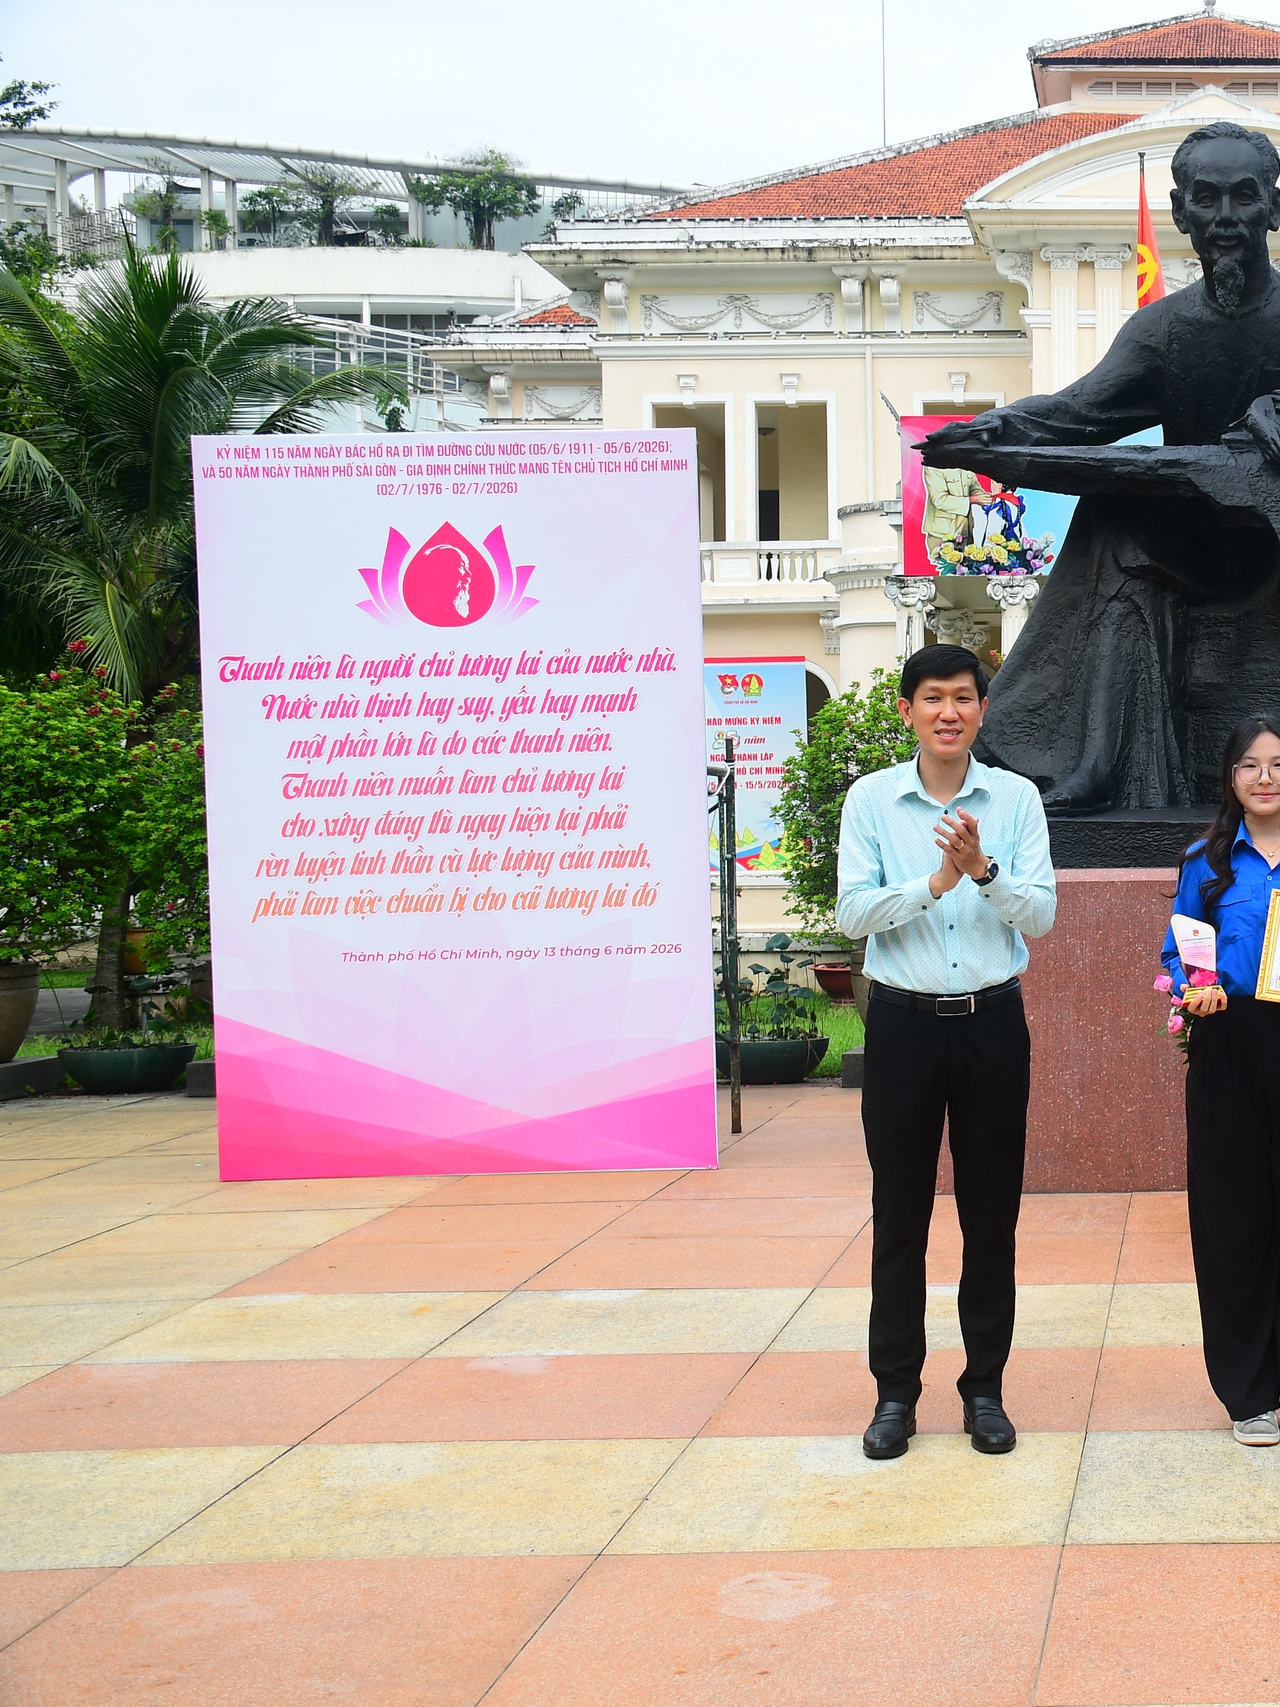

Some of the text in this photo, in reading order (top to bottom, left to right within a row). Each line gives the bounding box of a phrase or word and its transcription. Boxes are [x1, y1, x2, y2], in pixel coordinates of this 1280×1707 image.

[216, 440, 672, 462] KỶ NIỆM 115 NĂM NGÀY BÁC HỒ RA ĐI TÌM ĐƯỜNG CỨU NƯỚC (05/6/1911 05/6/2026);
[201, 457, 688, 479] VÀ 50 NĂM NGÀY THÀNH PHỐ SÀI GÒN GIA ĐỊNH CHÍNH THỨC MANG TÊN CHỦ TỊCH HỒ CHÍ MINH
[376, 480, 518, 496] (02/7/1976 02/7/2026)
[218, 646, 677, 686] Thanh niên là người chủ tương lai của nước nhà.
[261, 684, 638, 724] Nước nhà thịnh hay suy, yếu hay mạnh
[705, 716, 722, 726] HÀO
[762, 714, 782, 726] NIỆM
[341, 943, 682, 964] Thành phố Hồ Chí Minh, ngày 13 tháng 6 năm 2026
